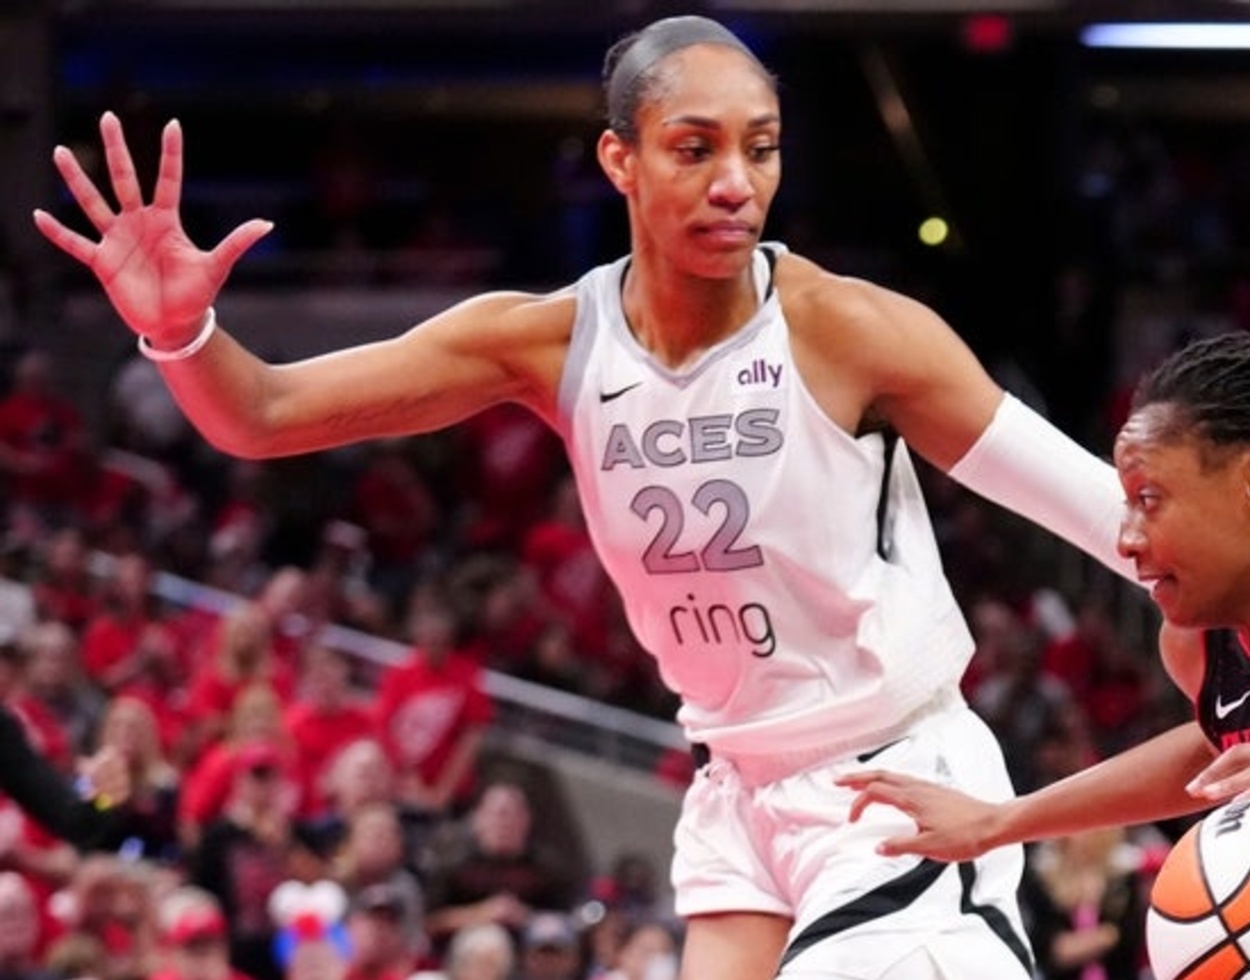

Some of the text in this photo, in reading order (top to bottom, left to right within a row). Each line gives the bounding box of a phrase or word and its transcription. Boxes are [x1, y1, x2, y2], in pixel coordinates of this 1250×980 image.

[737, 359, 783, 388] ally
[601, 408, 784, 471] ACES
[630, 478, 764, 575] 22
[669, 593, 776, 657] ring
